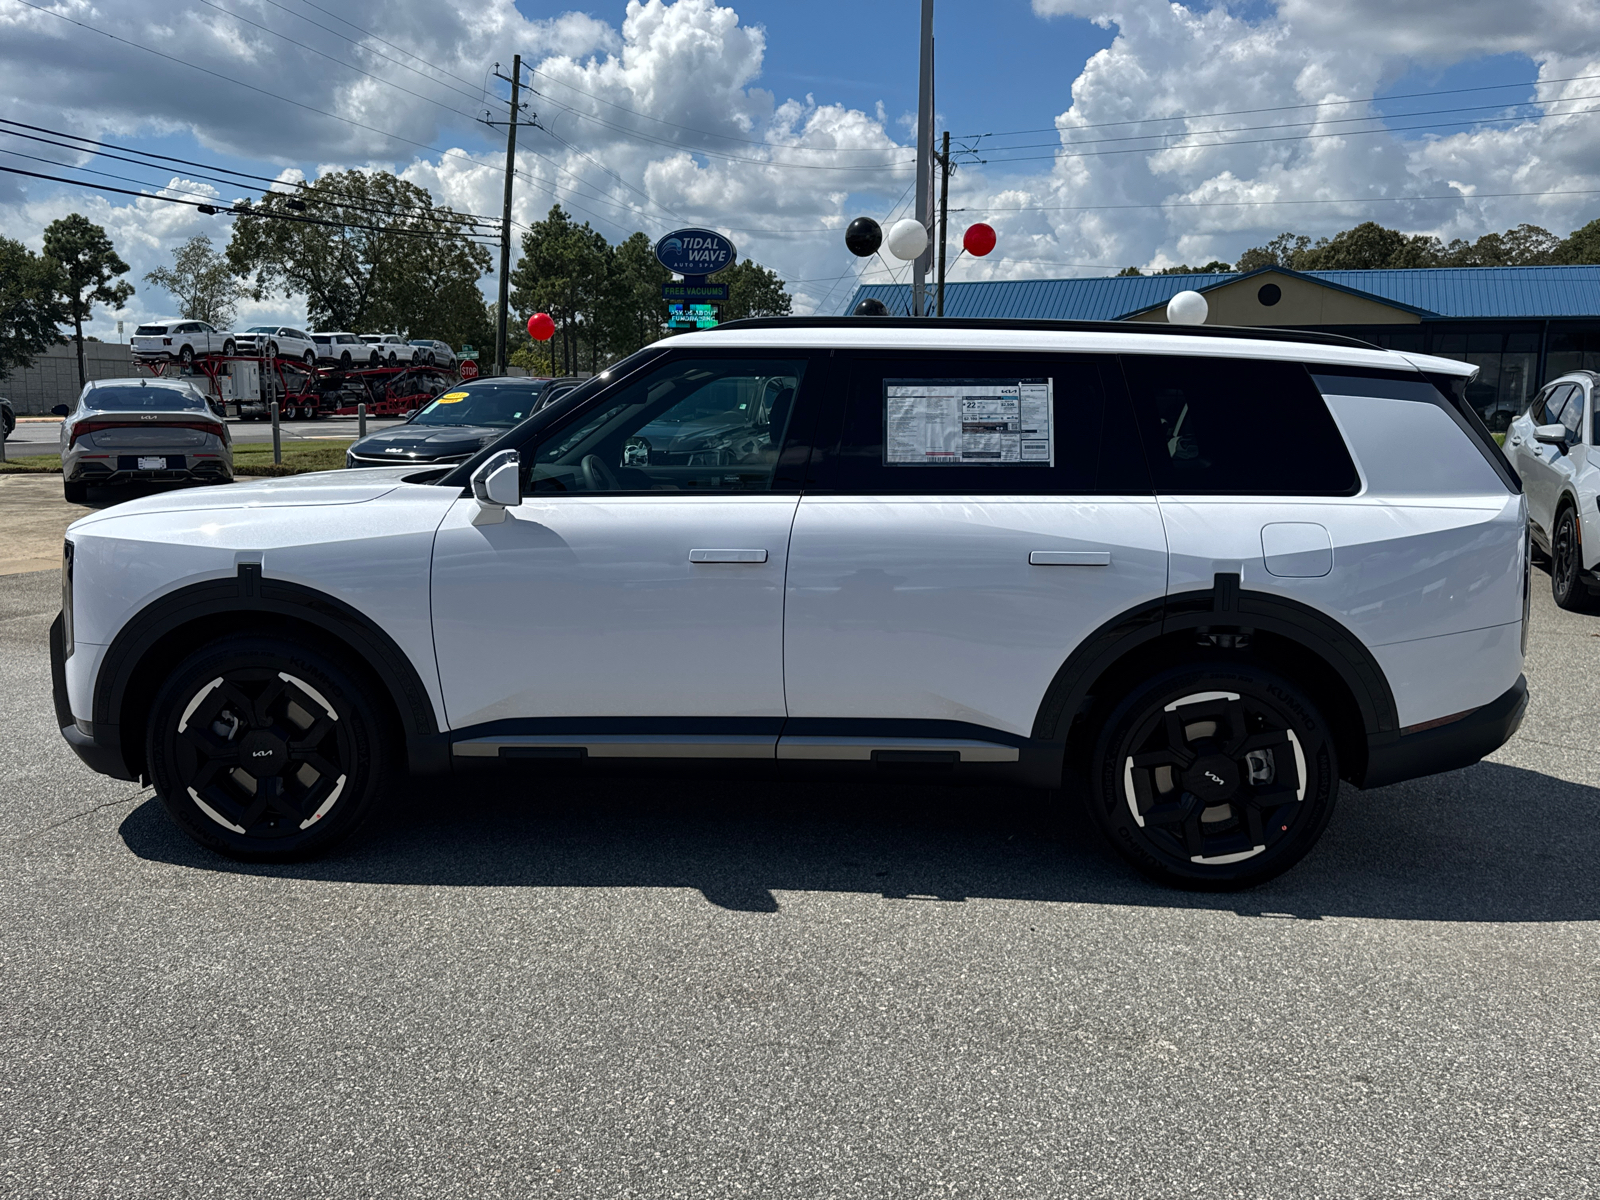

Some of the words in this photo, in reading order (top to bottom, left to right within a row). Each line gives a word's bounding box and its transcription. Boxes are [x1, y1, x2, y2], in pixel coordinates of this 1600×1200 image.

[683, 238, 719, 249] TIDAL
[688, 250, 726, 262] WAVE
[664, 287, 685, 295] FREE
[686, 287, 723, 295] VACUUMS
[461, 366, 477, 376] STOP
[966, 401, 976, 409] 22
[289, 656, 344, 698] KUMHO
[1266, 683, 1316, 732] KUMHO
[252, 749, 273, 758] KIA
[1118, 825, 1170, 871] KUMHO
